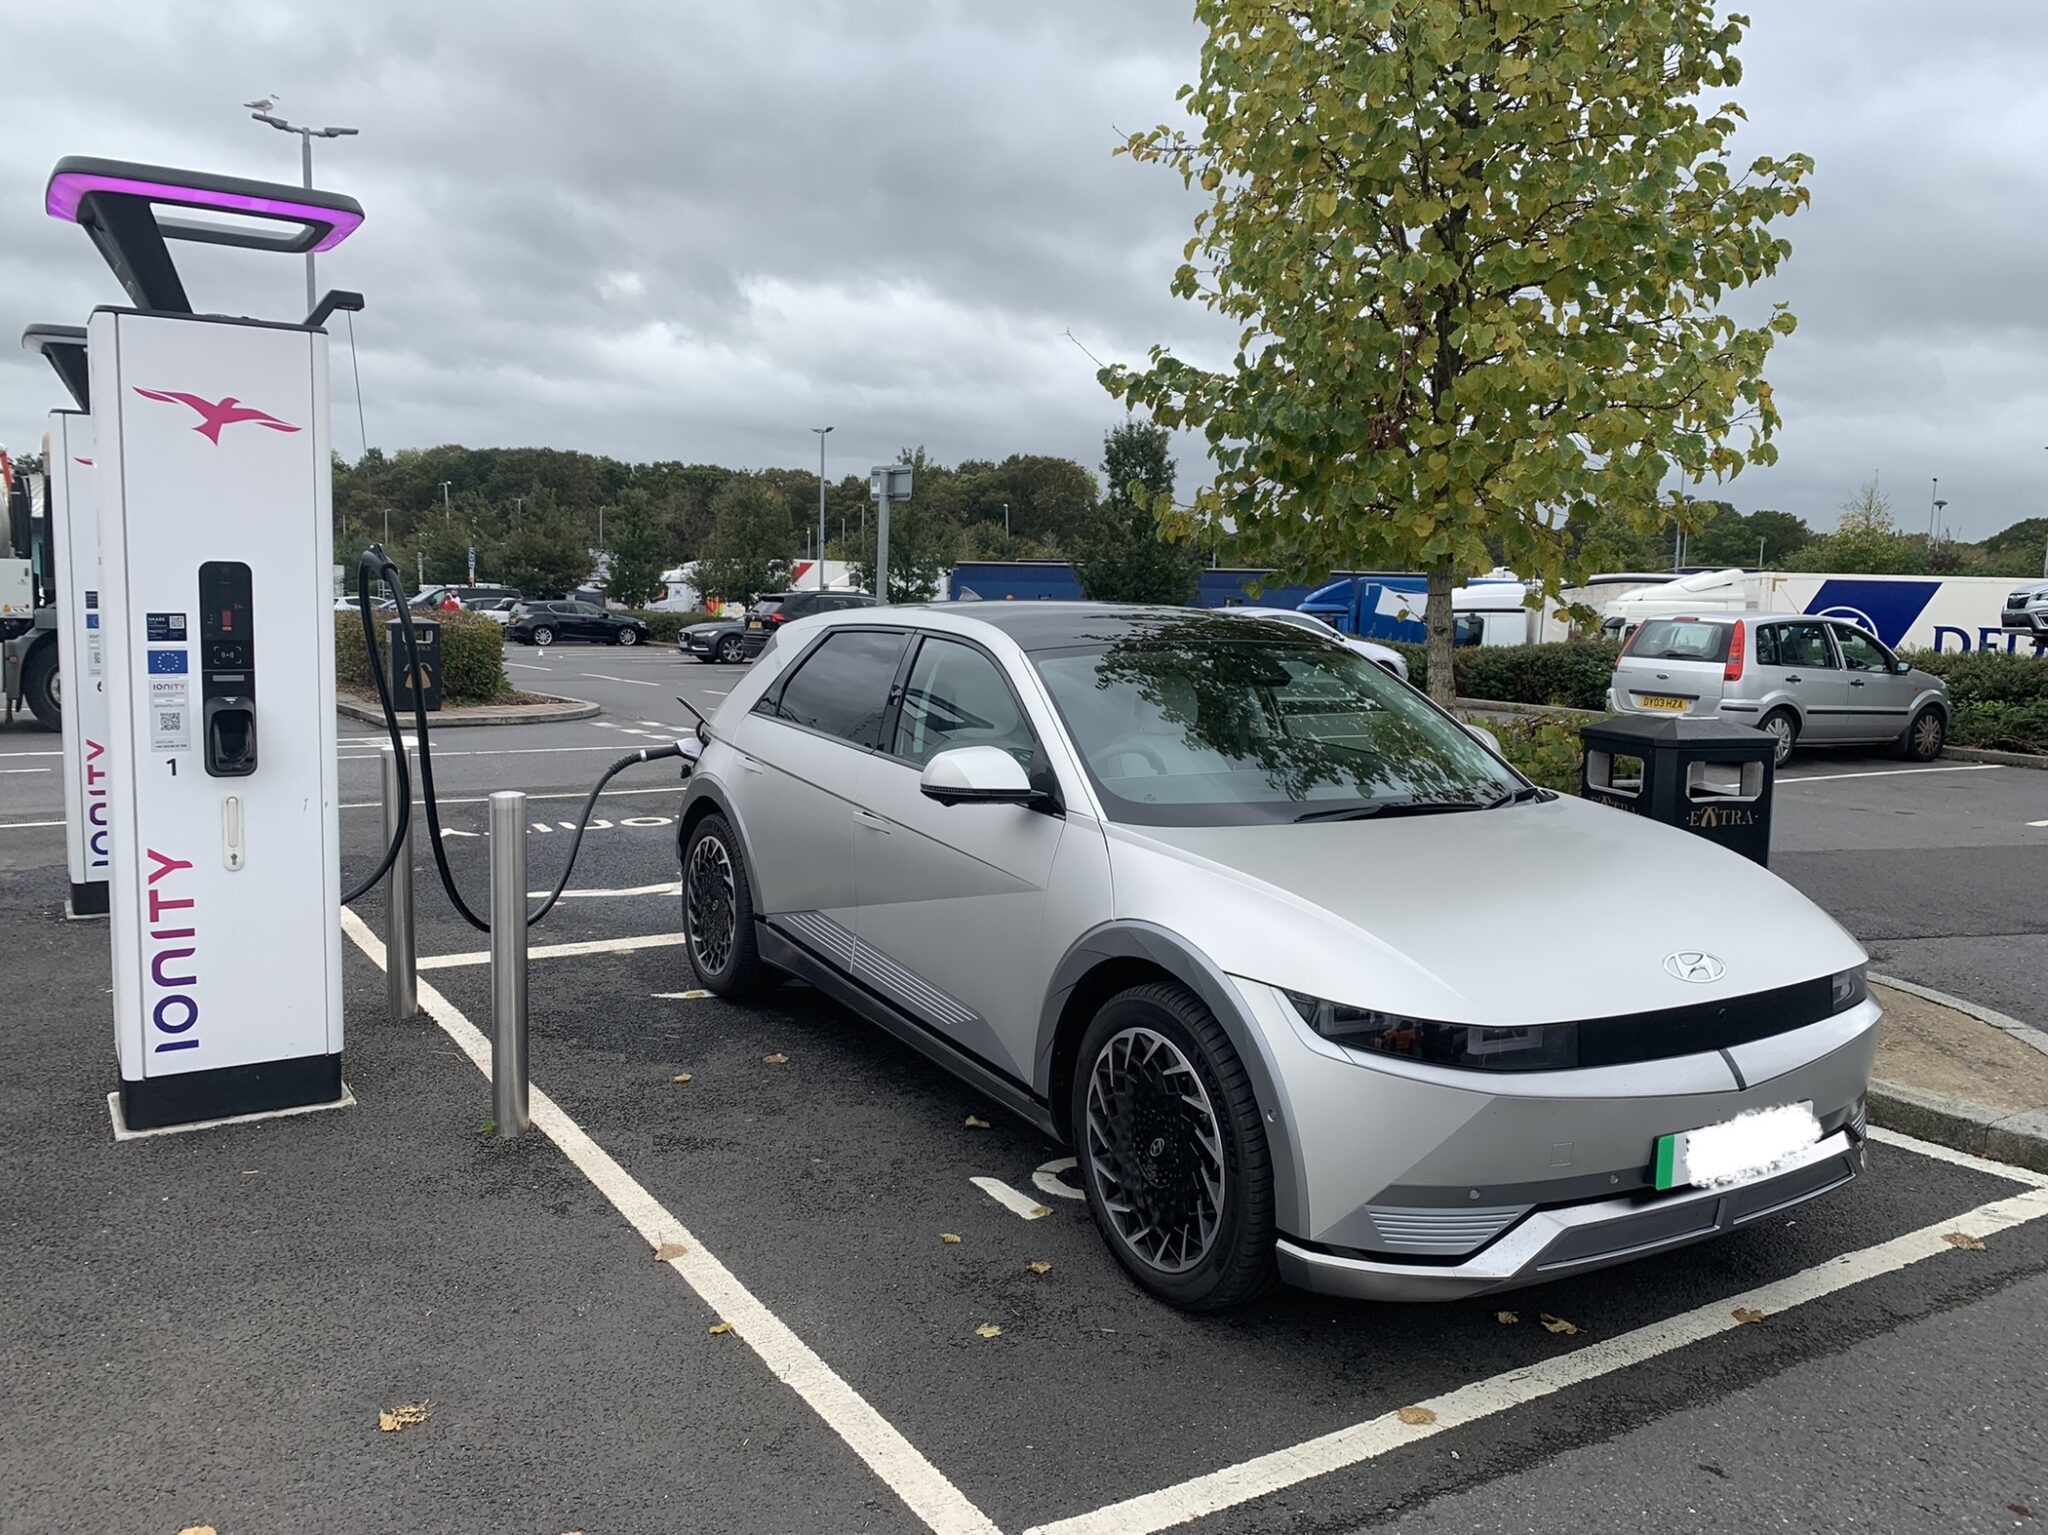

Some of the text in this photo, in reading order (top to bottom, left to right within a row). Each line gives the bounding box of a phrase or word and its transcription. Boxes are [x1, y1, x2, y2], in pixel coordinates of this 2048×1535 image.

[153, 683, 186, 691] IONITY
[1665, 698, 1684, 709] HZA
[166, 758, 177, 776] 1
[147, 848, 200, 1053] IONITY
